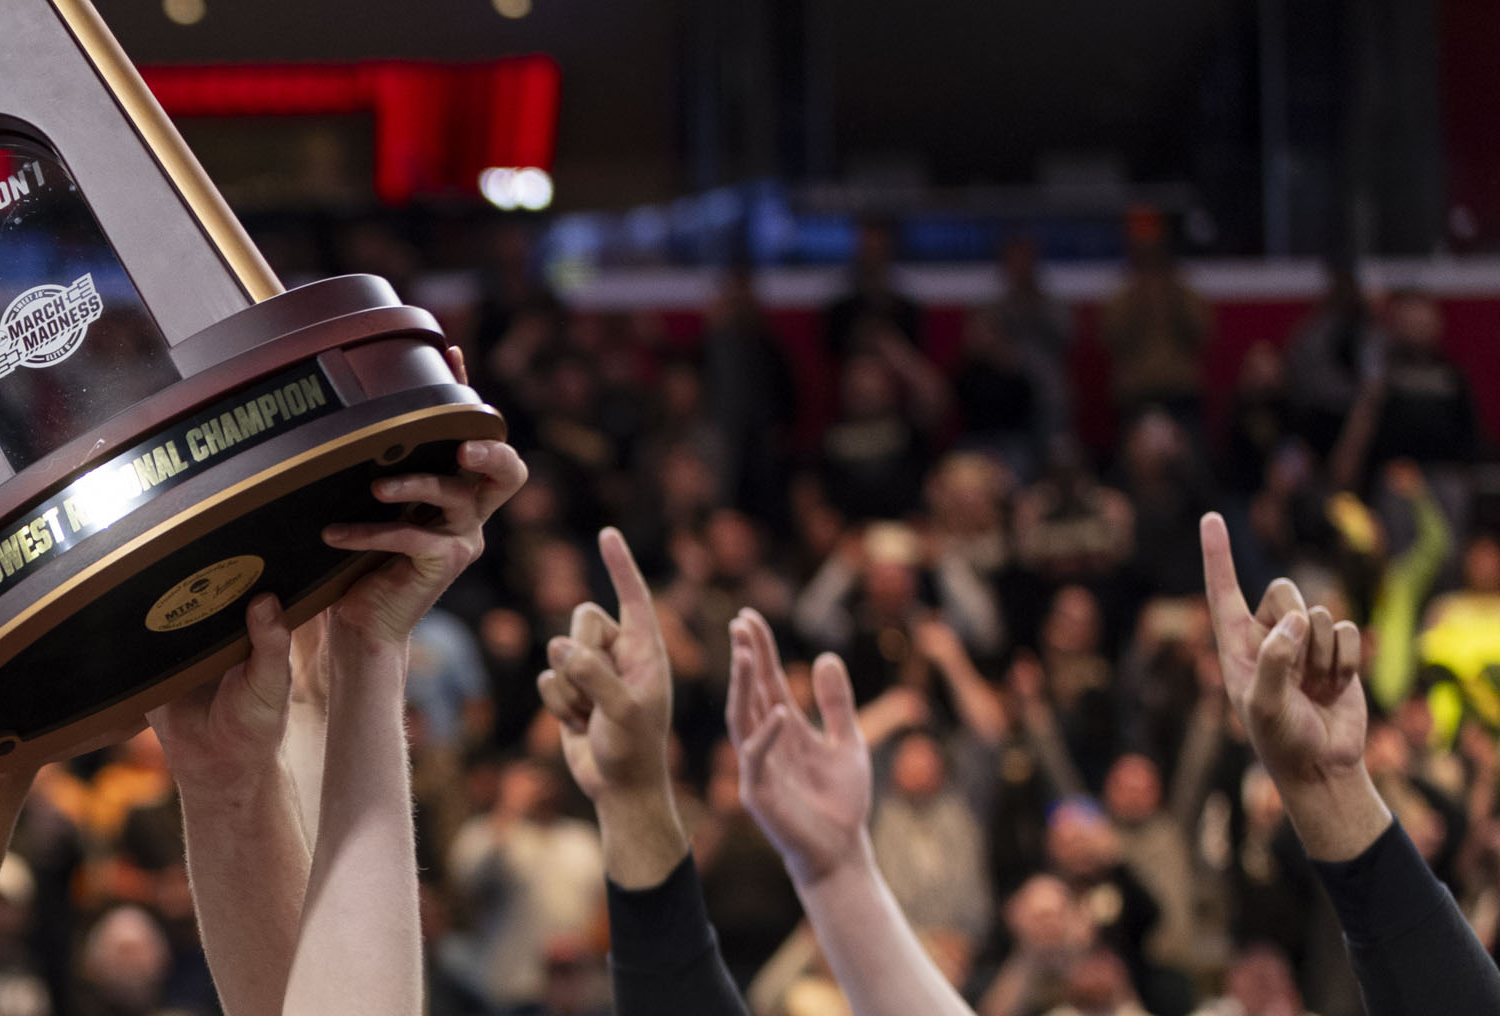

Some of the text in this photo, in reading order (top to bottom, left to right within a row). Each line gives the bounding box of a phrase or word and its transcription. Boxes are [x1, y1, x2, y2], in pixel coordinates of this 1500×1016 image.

[7, 296, 66, 341] MARCH
[22, 295, 101, 352] MADNESS
[185, 374, 326, 463] CHAMPION
